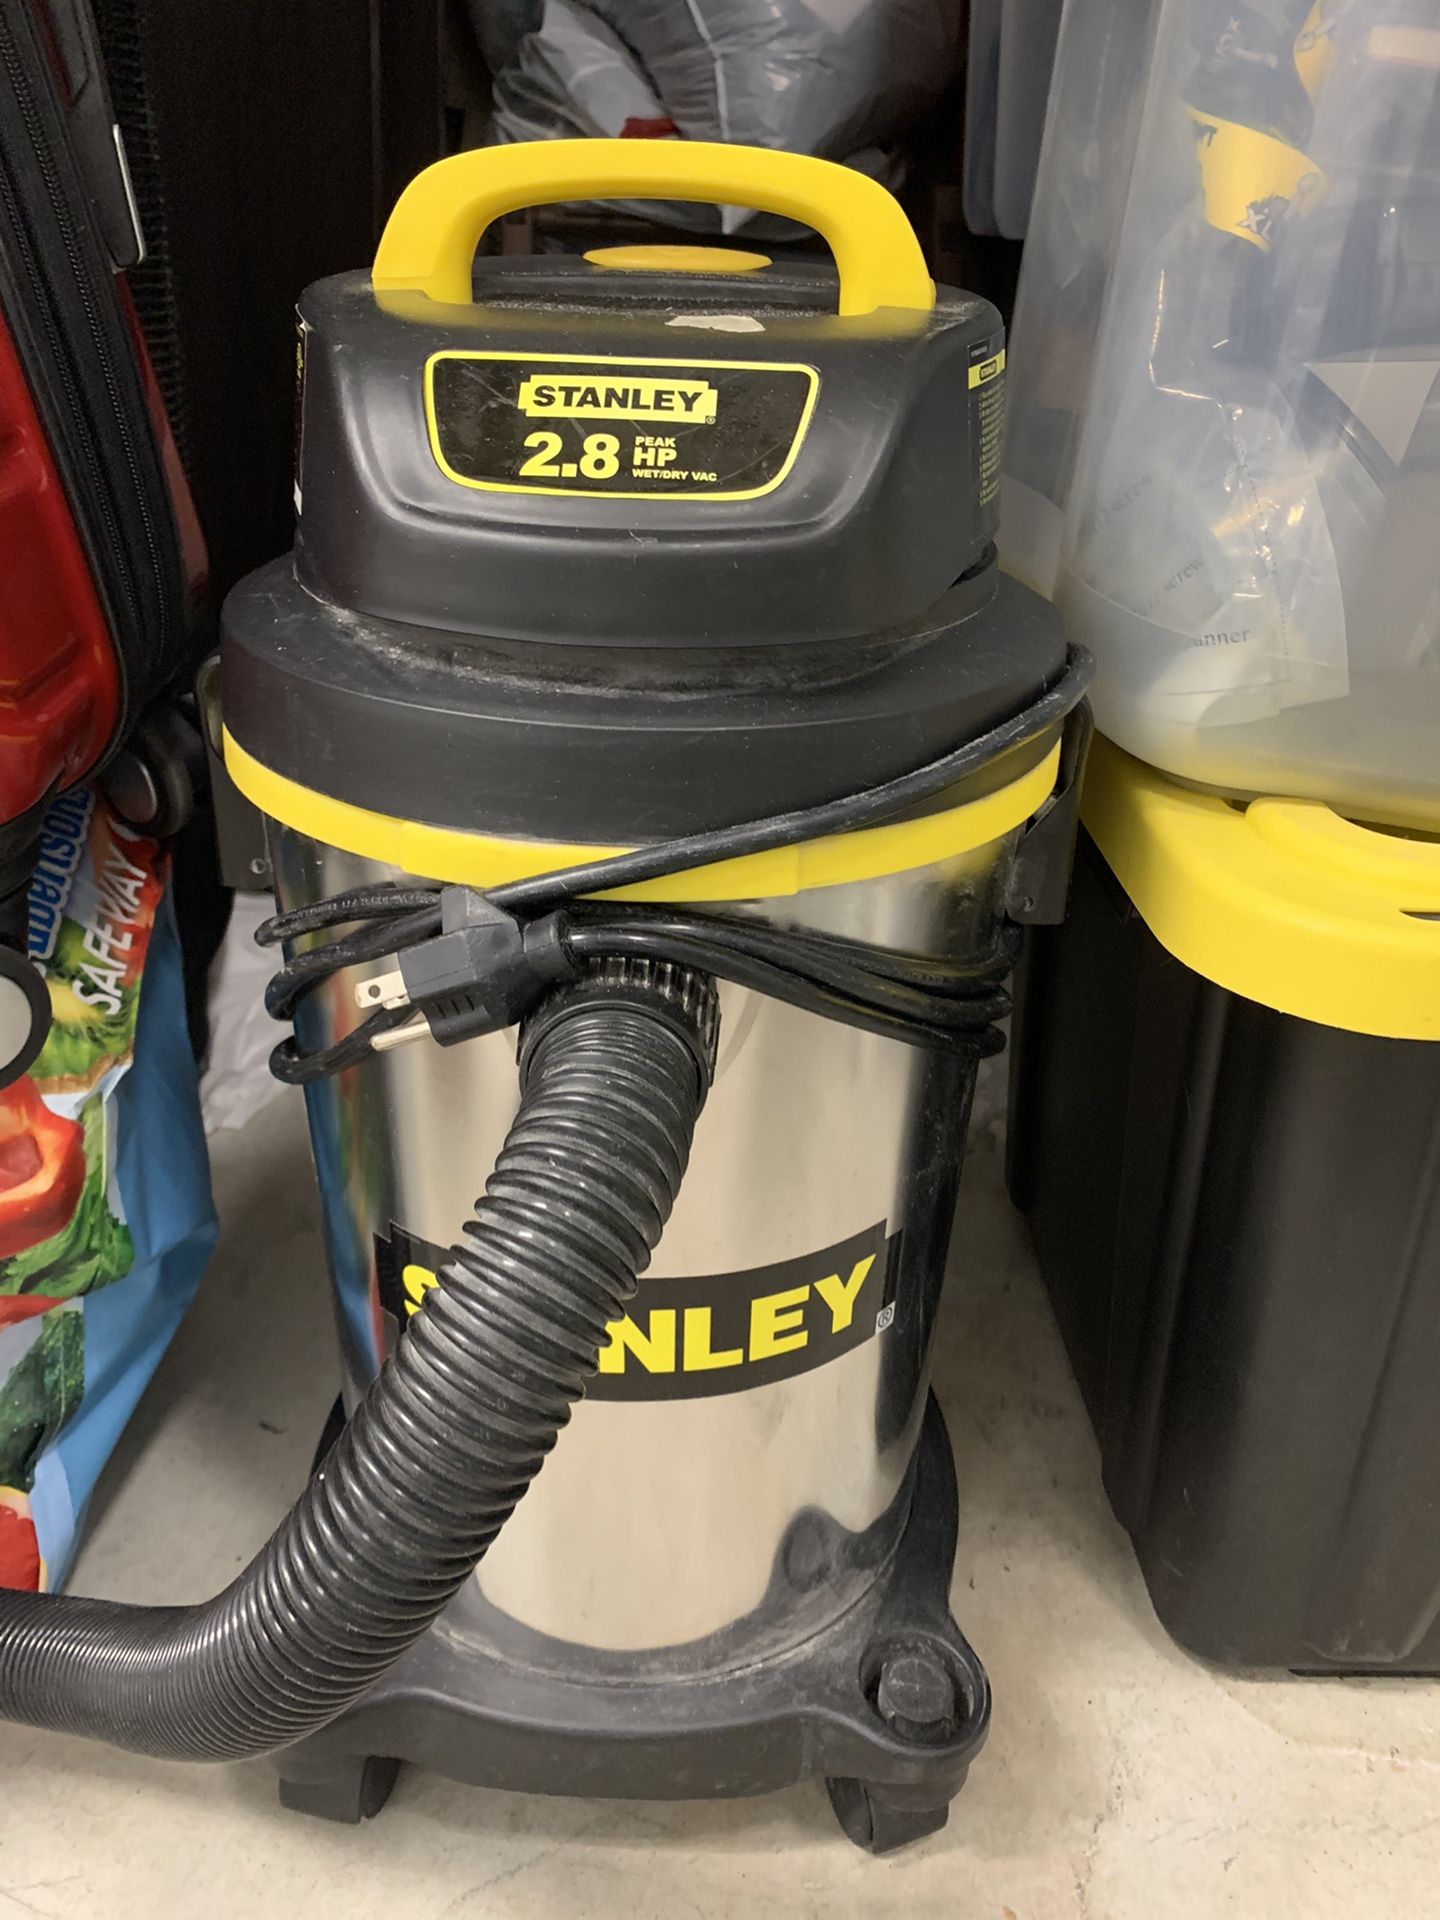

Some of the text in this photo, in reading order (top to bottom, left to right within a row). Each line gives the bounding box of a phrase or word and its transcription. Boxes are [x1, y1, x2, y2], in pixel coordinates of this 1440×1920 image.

[533, 385, 702, 412] STANLEY
[519, 431, 620, 479] 2.8
[635, 436, 676, 447] PEAK
[633, 447, 677, 467] HP
[632, 469, 717, 482] WET/DRY VAC
[72, 842, 147, 1015] SAFEWAY
[402, 1253, 878, 1375] SNLEY
